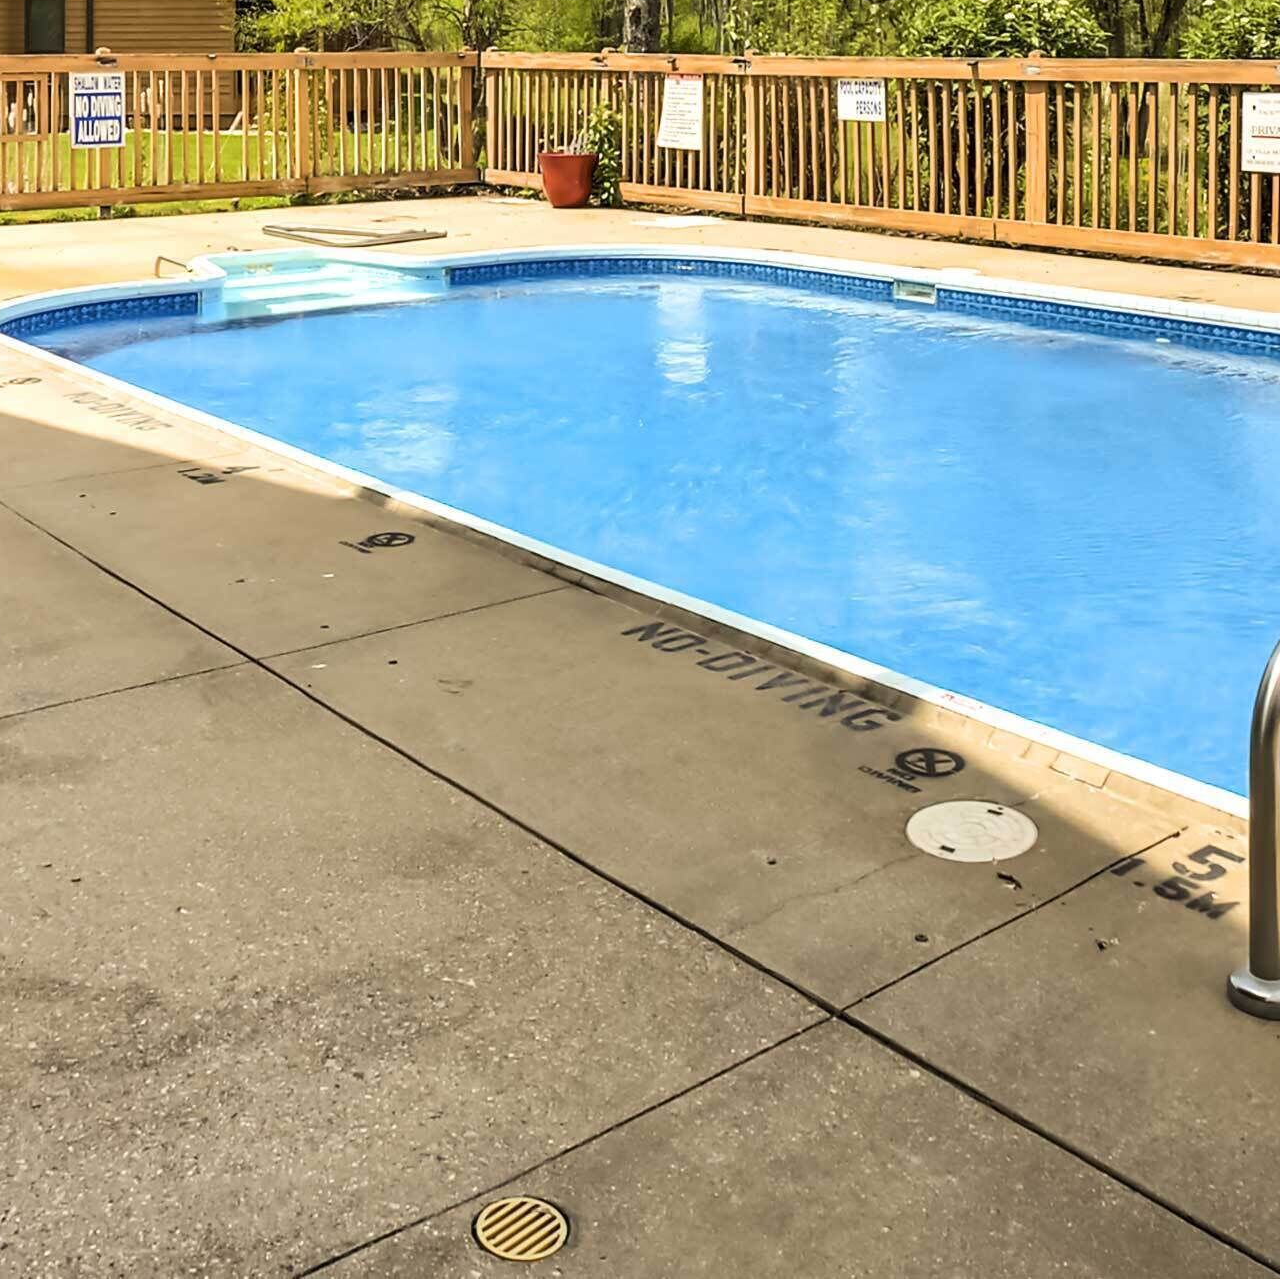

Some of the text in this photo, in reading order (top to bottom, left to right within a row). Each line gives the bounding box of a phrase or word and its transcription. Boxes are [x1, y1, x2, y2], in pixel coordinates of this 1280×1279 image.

[76, 95, 121, 118] NO DIVING
[77, 119, 120, 143] ALLOWED
[620, 621, 903, 732] NO-DIVING
